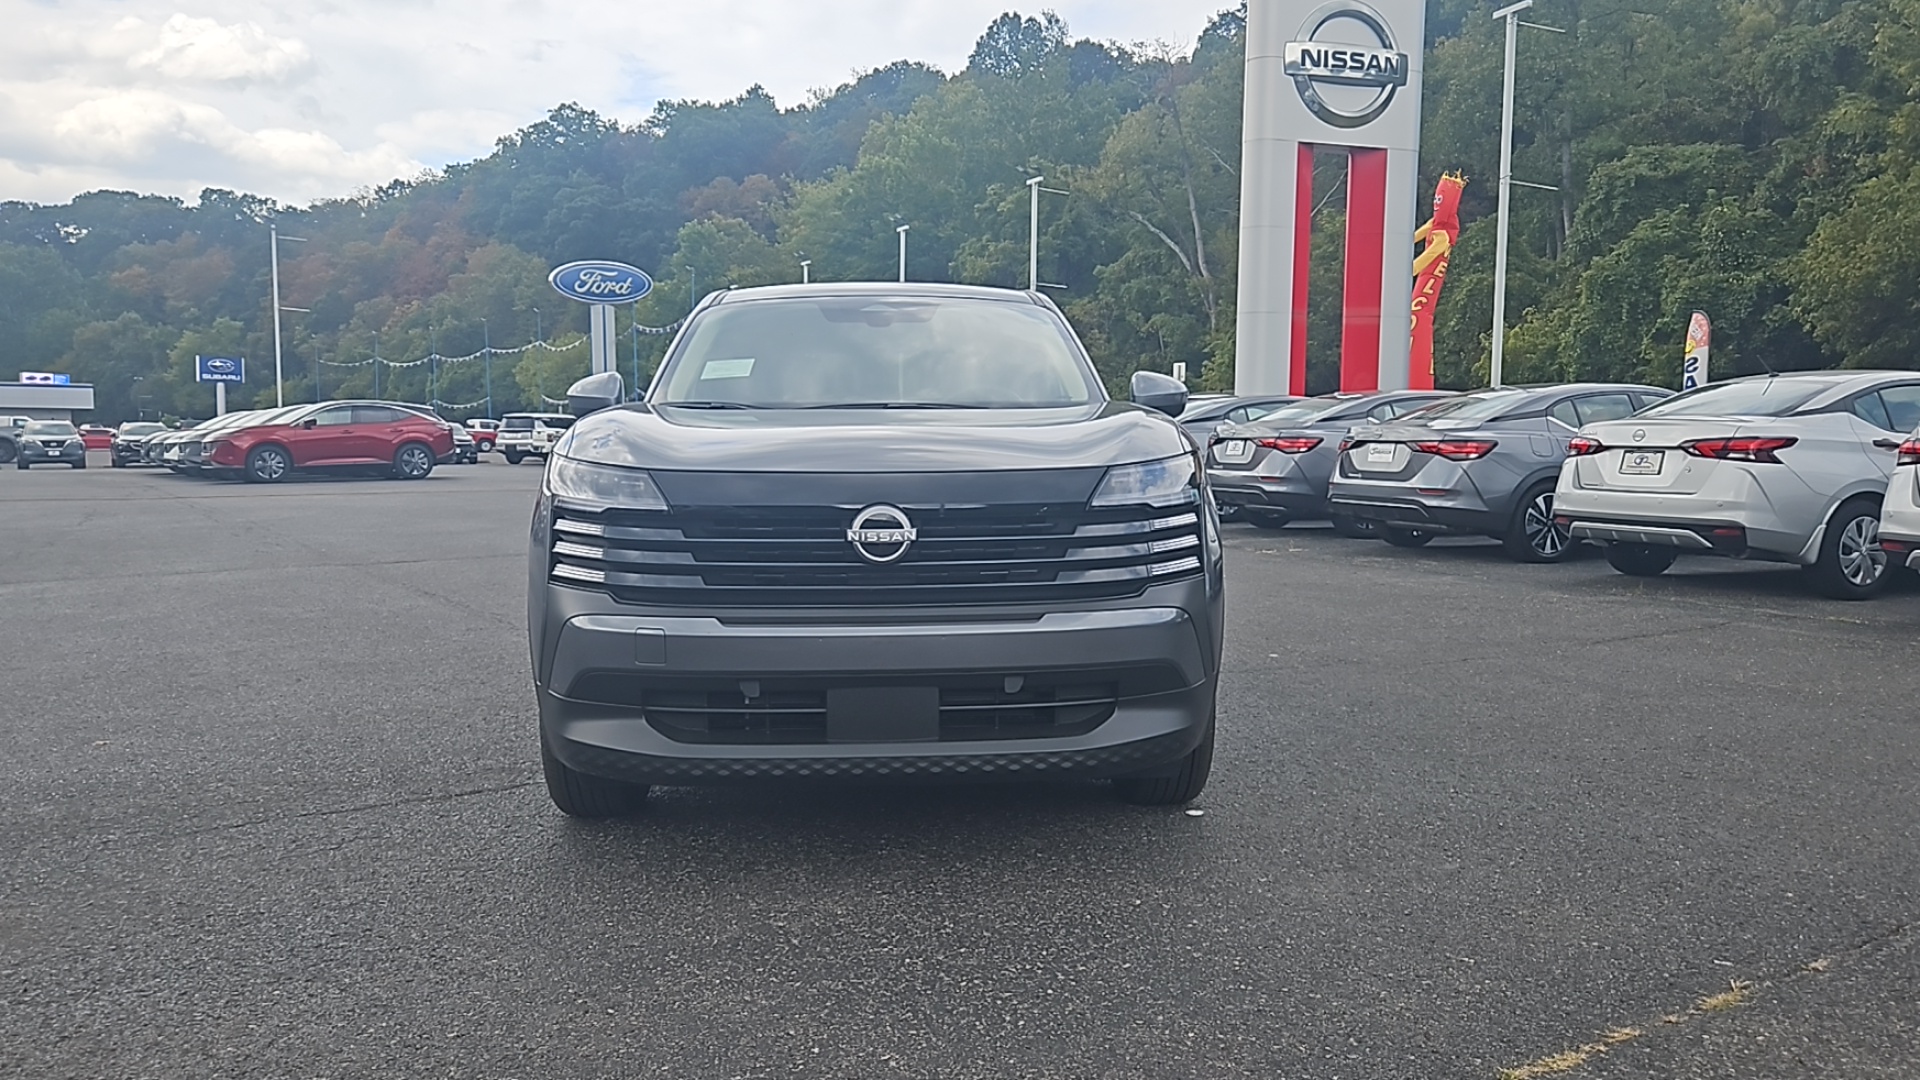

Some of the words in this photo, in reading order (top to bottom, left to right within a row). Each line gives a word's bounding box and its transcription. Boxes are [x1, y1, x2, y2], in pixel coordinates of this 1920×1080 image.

[1300, 49, 1399, 77] NISSAN
[574, 269, 632, 294] Ford
[202, 373, 241, 381] SUBARU
[848, 531, 916, 542] NISSAN
